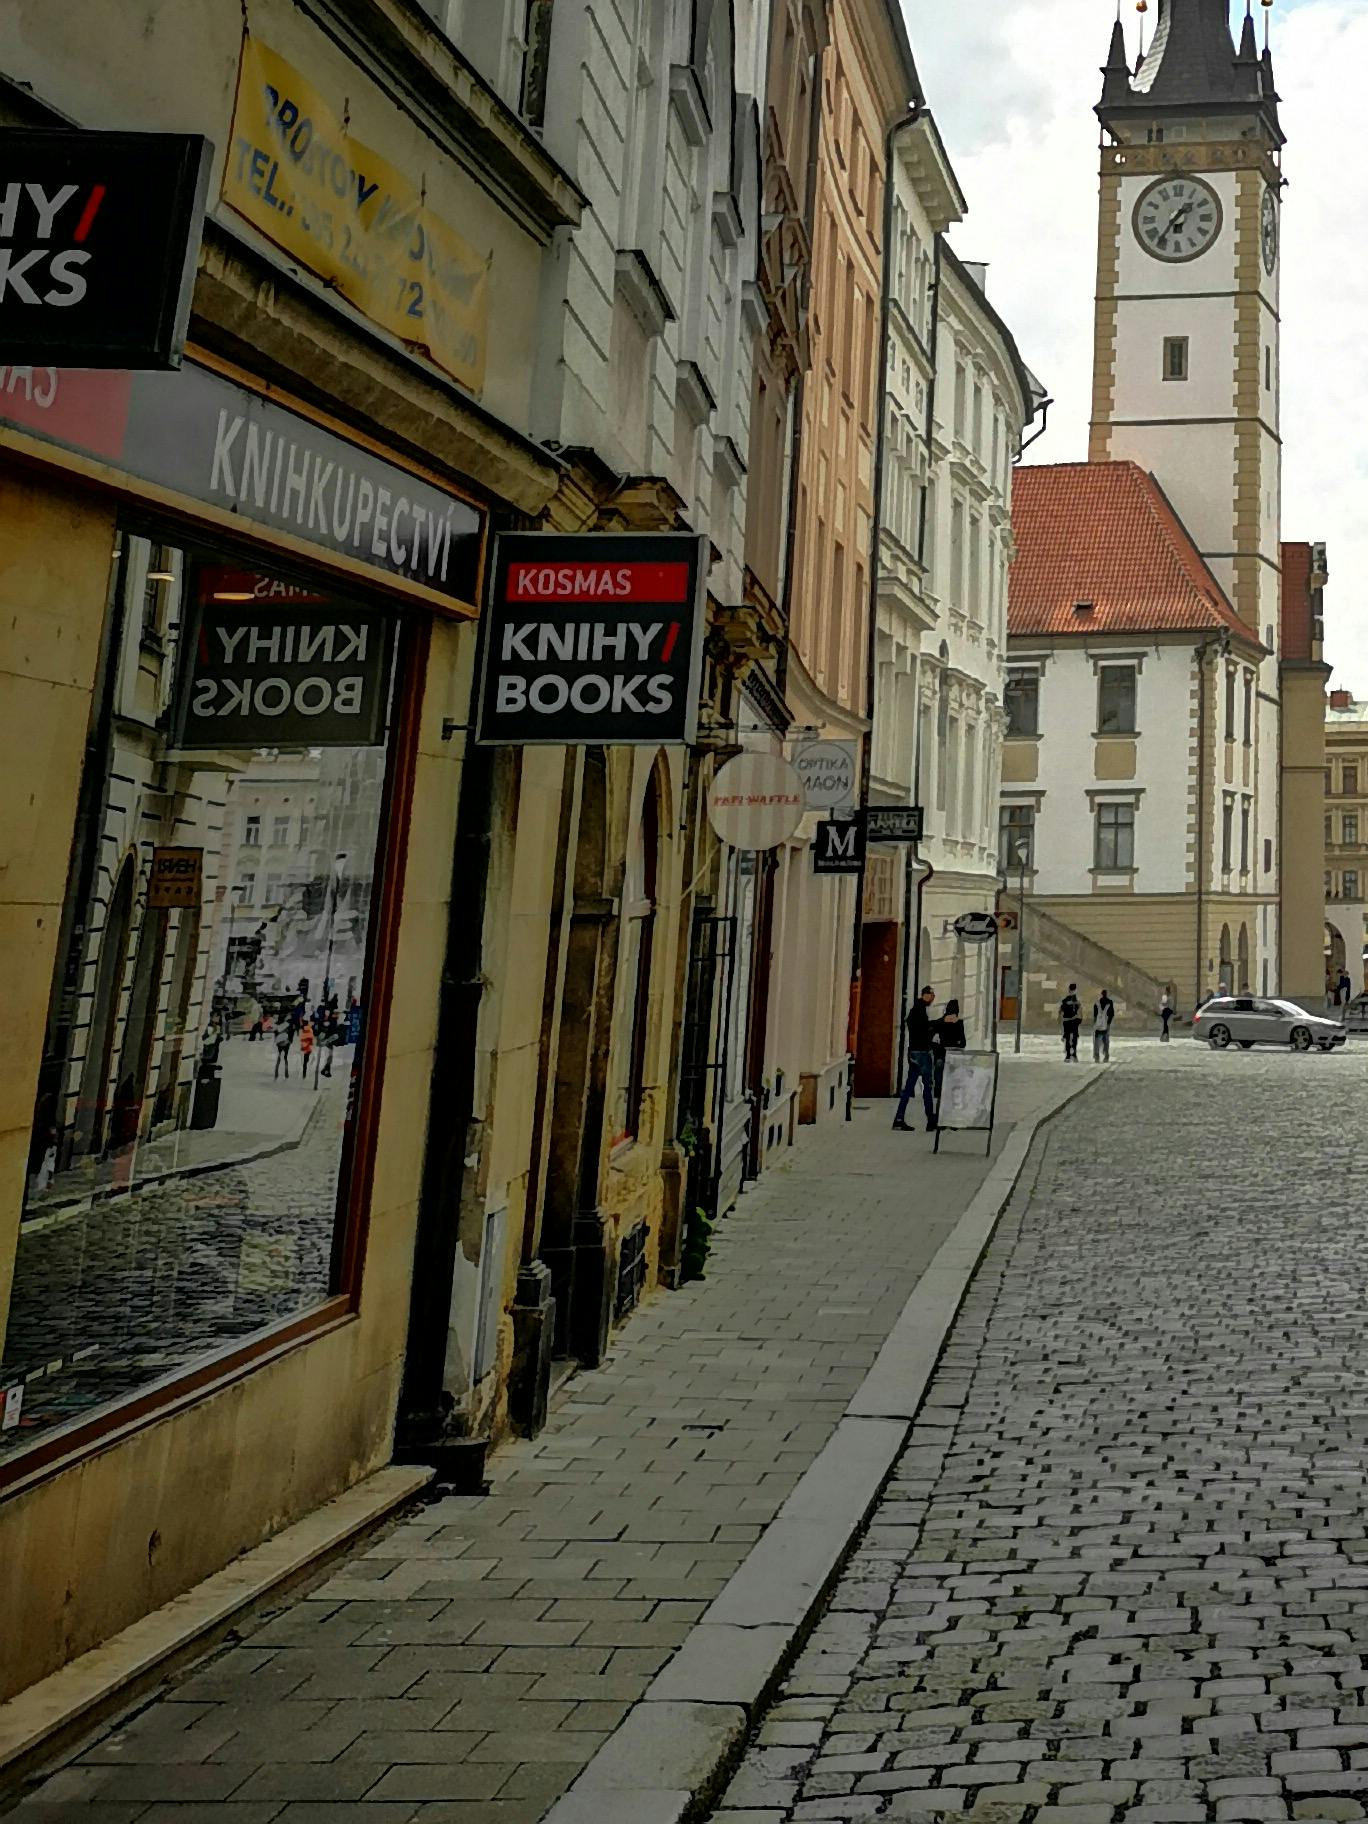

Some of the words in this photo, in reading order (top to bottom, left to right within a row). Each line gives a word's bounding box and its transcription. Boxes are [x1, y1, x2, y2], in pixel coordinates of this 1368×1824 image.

[210, 407, 457, 582] KNIHKUPECTVÍ
[517, 568, 632, 596] KOSMAS
[496, 673, 675, 714] BOOKS
[825, 826, 858, 857] M
